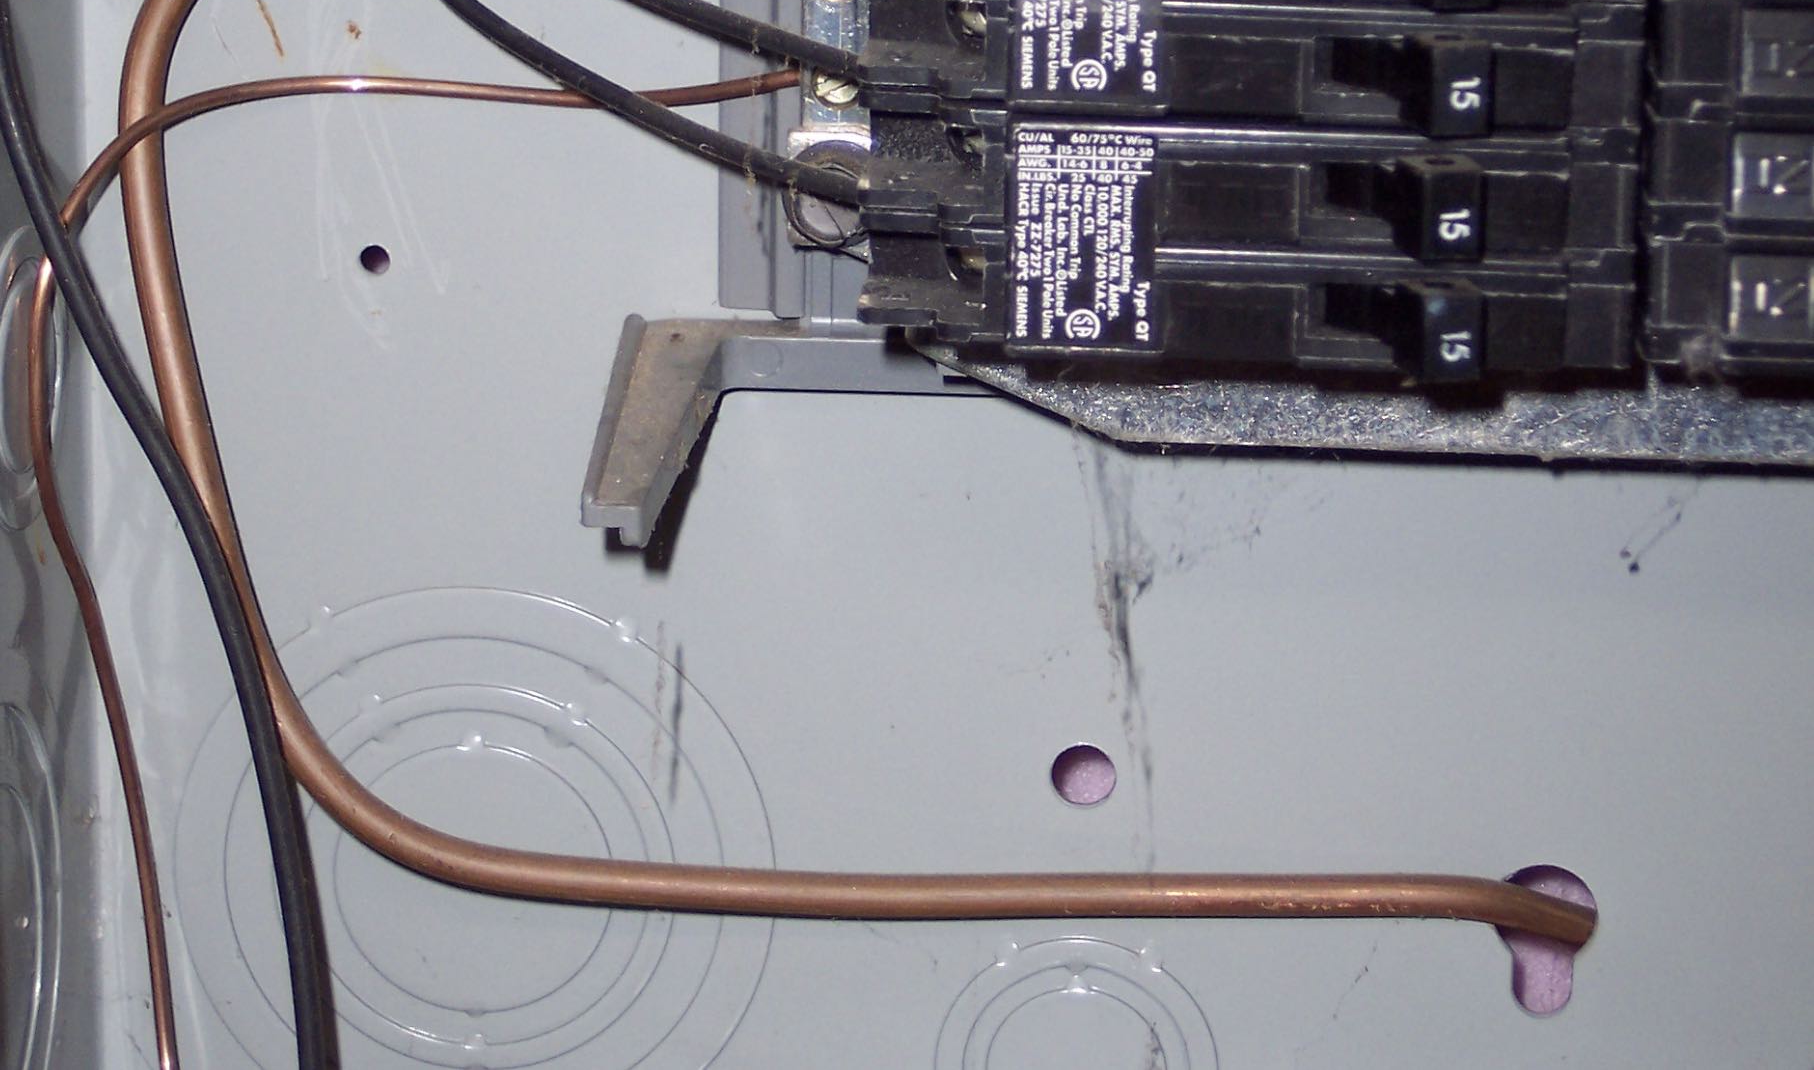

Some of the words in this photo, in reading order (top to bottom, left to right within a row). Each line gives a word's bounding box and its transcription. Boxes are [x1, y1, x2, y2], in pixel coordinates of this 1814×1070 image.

[1450, 77, 1481, 110] 15
[1018, 132, 1054, 143] CU/AL
[1125, 135, 1152, 145] Wire
[1019, 144, 1050, 154] AMPS
[1061, 146, 1092, 155] 15-35
[1098, 146, 1113, 156] 40
[1120, 147, 1154, 157] 40-50
[1062, 159, 1088, 169] 14-6
[1100, 160, 1108, 170] 8
[1071, 173, 1086, 182] 25
[1097, 174, 1113, 183] 40
[1122, 175, 1138, 184] 45
[1018, 183, 1030, 216] HACR
[1031, 183, 1043, 215] Issue
[1071, 184, 1082, 201] No
[1084, 184, 1096, 214] Class
[1014, 219, 1029, 248] Type
[1044, 203, 1056, 248] Breaker
[1070, 204, 1082, 254] Common
[1083, 216, 1095, 236] CTL
[1119, 185, 1136, 253] Interrupting
[1438, 208, 1471, 241] 15
[1030, 222, 1042, 277] ZZ-7275
[1043, 250, 1055, 275] Two
[1095, 229, 1108, 278] 120/240
[1068, 257, 1081, 280] Trip
[1119, 256, 1134, 293] Rating
[1042, 283, 1055, 308] Pole
[1133, 281, 1150, 317] Type
[1016, 286, 1028, 337] SIEMENS
[1042, 310, 1054, 339] Units
[1136, 320, 1149, 341] QT
[1441, 331, 1471, 362] 15
